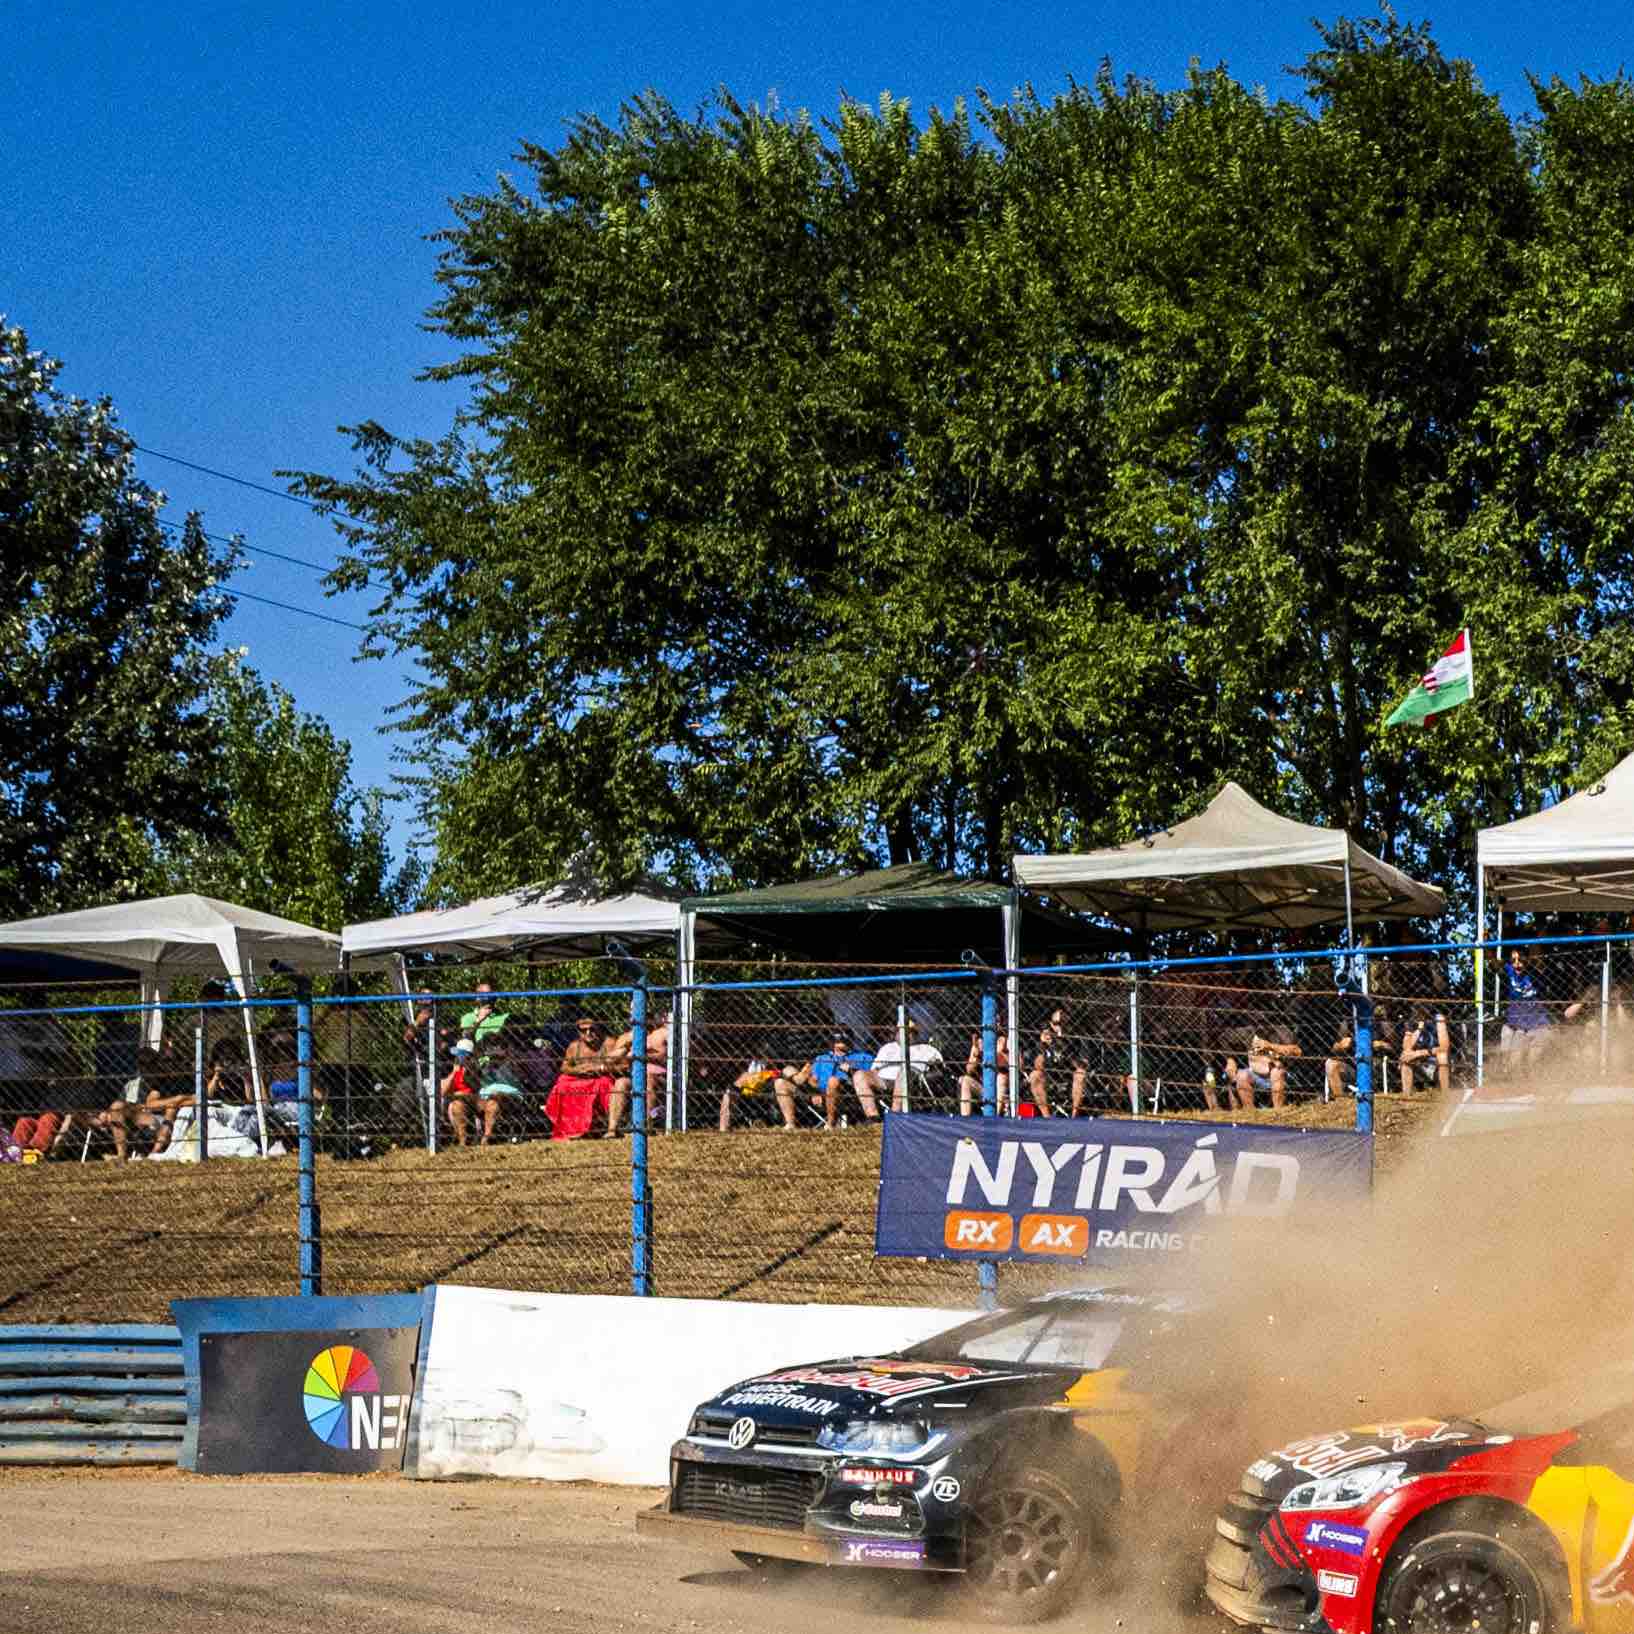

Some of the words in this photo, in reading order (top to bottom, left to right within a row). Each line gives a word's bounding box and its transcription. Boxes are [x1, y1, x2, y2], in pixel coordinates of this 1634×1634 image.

[957, 1219, 999, 1244] RX
[1031, 1222, 1078, 1248] AX
[1095, 1229, 1185, 1252] RACING
[721, 1391, 841, 1416] POWERTRAIN
